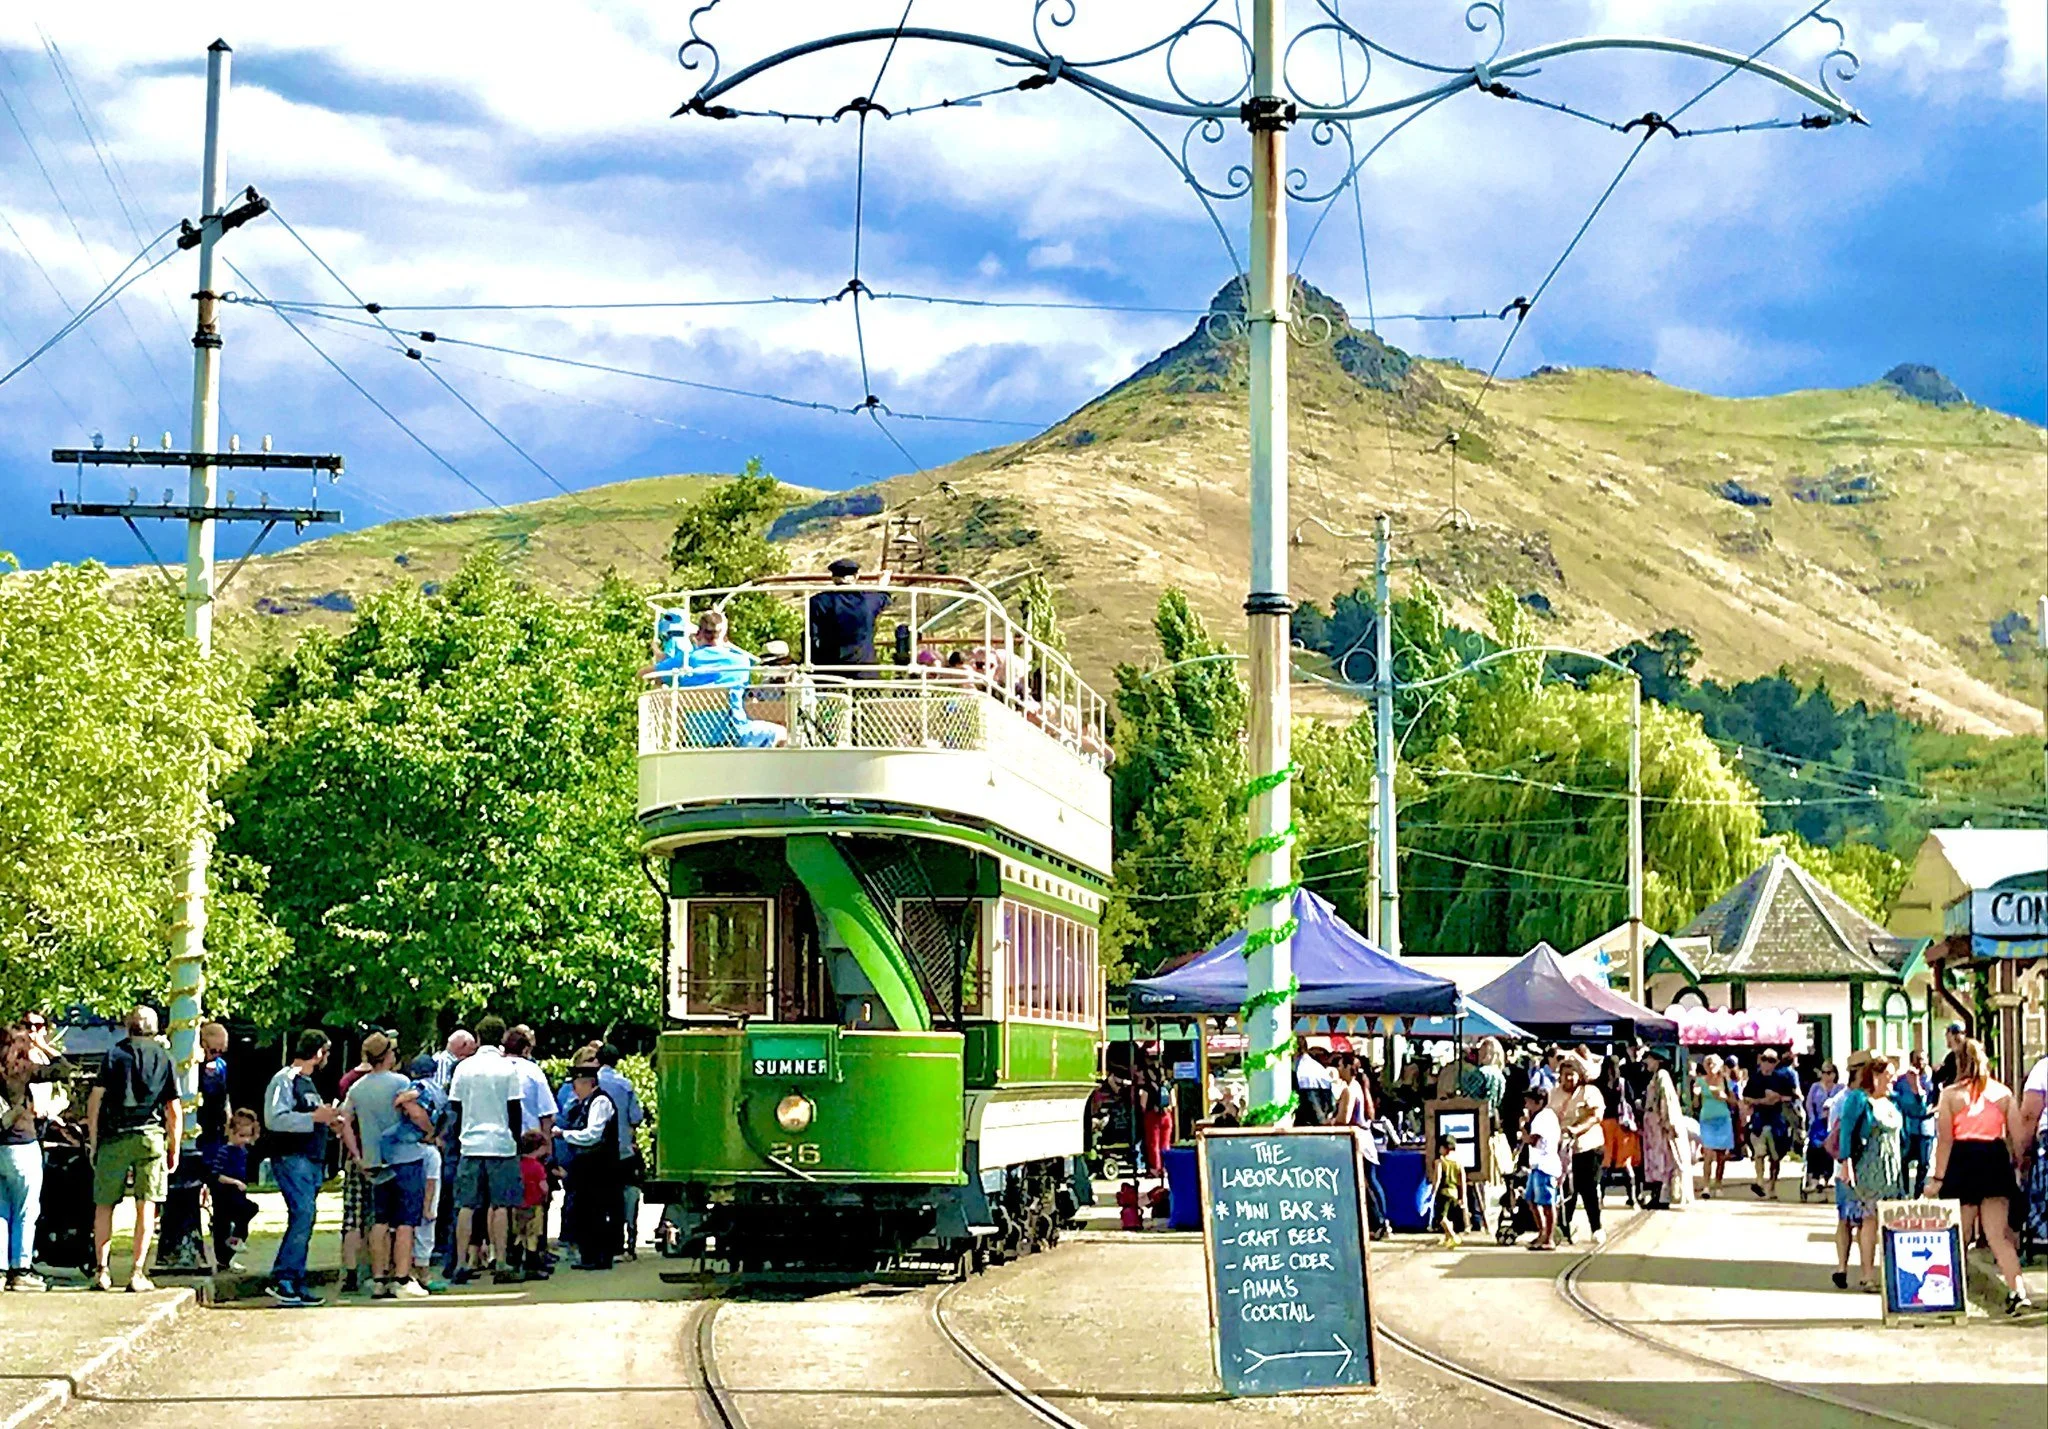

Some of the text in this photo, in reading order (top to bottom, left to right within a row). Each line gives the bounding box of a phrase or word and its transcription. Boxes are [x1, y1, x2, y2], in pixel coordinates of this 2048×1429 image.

[754, 1059, 827, 1075] SUMNER
[770, 1142, 821, 1164] 26
[1251, 1141, 1291, 1165] THE
[1222, 1167, 1340, 1196] LABORATORY
[1235, 1200, 1318, 1221] MINI BAR
[1288, 1227, 1331, 1246] BEER
[1242, 1252, 1334, 1272] APPLE CIDER
[1241, 1302, 1315, 1322] COCKTAIL
